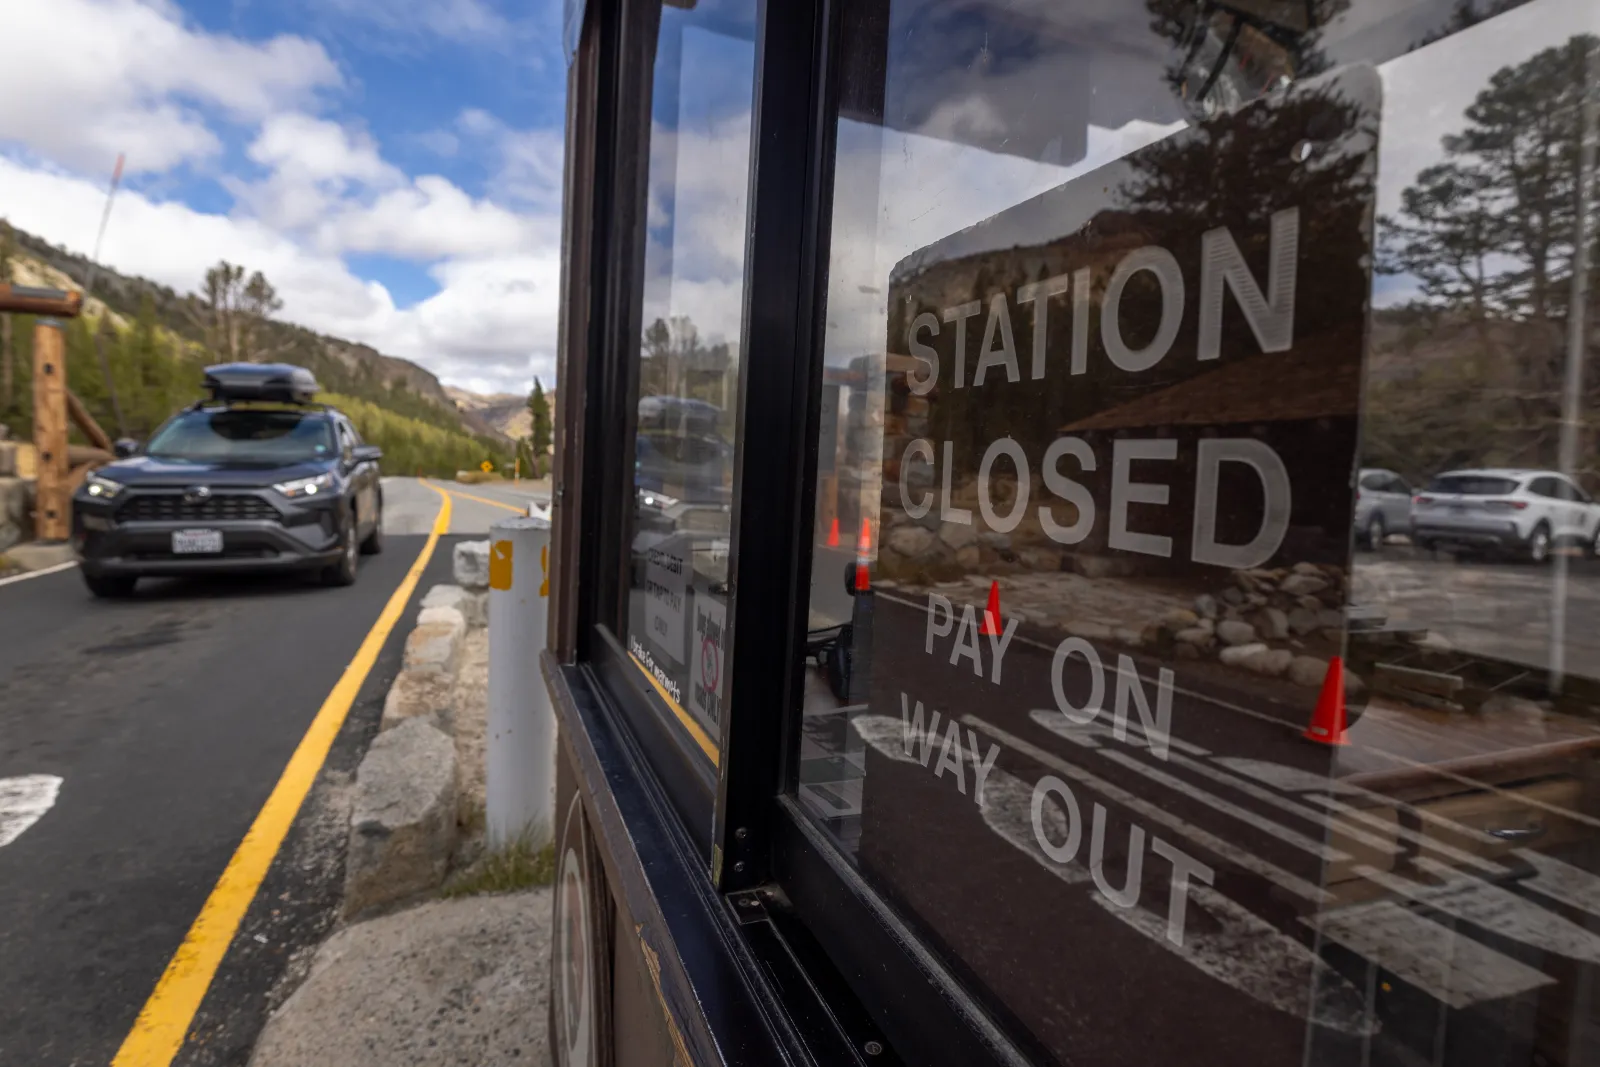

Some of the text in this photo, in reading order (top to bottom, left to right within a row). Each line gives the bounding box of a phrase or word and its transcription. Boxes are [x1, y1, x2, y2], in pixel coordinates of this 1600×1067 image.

[906, 206, 1299, 395] STATION
[900, 436, 1292, 569] CLOSED
[925, 592, 1175, 762] PAY ON
[901, 692, 1215, 947] WAY OUT
